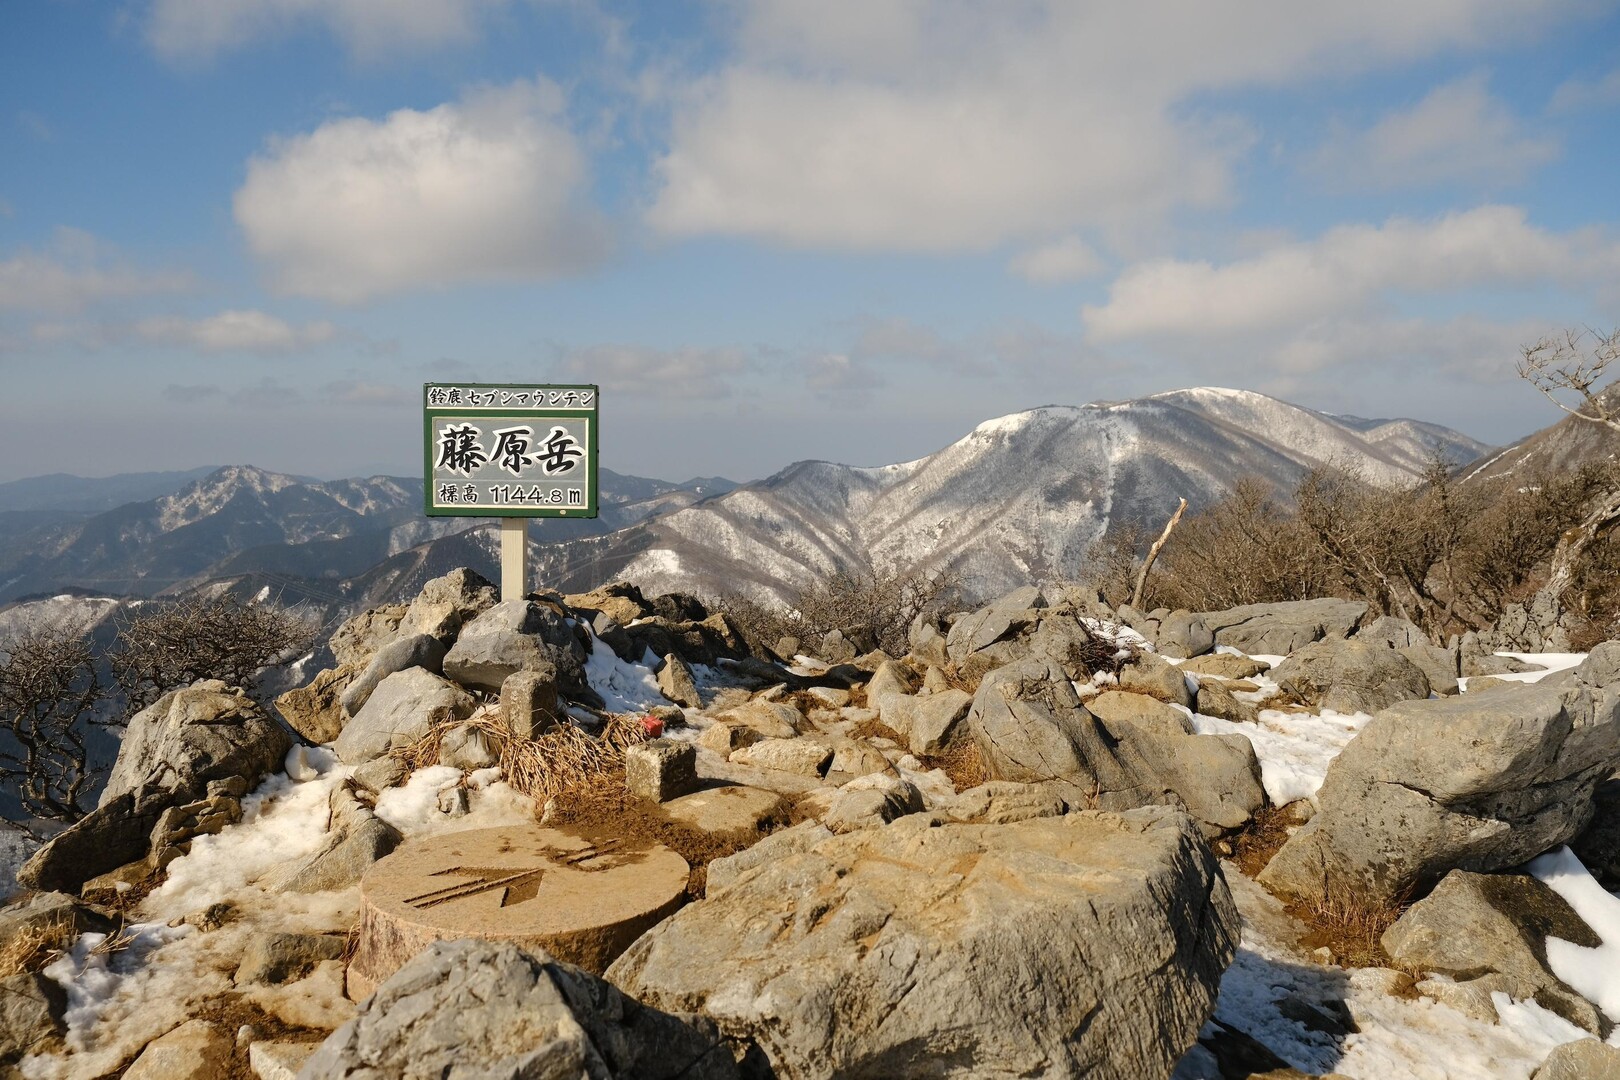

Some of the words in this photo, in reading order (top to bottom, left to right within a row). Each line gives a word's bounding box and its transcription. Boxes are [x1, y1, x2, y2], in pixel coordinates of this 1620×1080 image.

[429, 388, 462, 406] 鈴鹿
[467, 390, 594, 407] セブンマウンテン
[436, 425, 585, 475] 藤原岳
[439, 484, 478, 503] 標高
[490, 485, 563, 504] 1144.8
[568, 489, 581, 504] m
